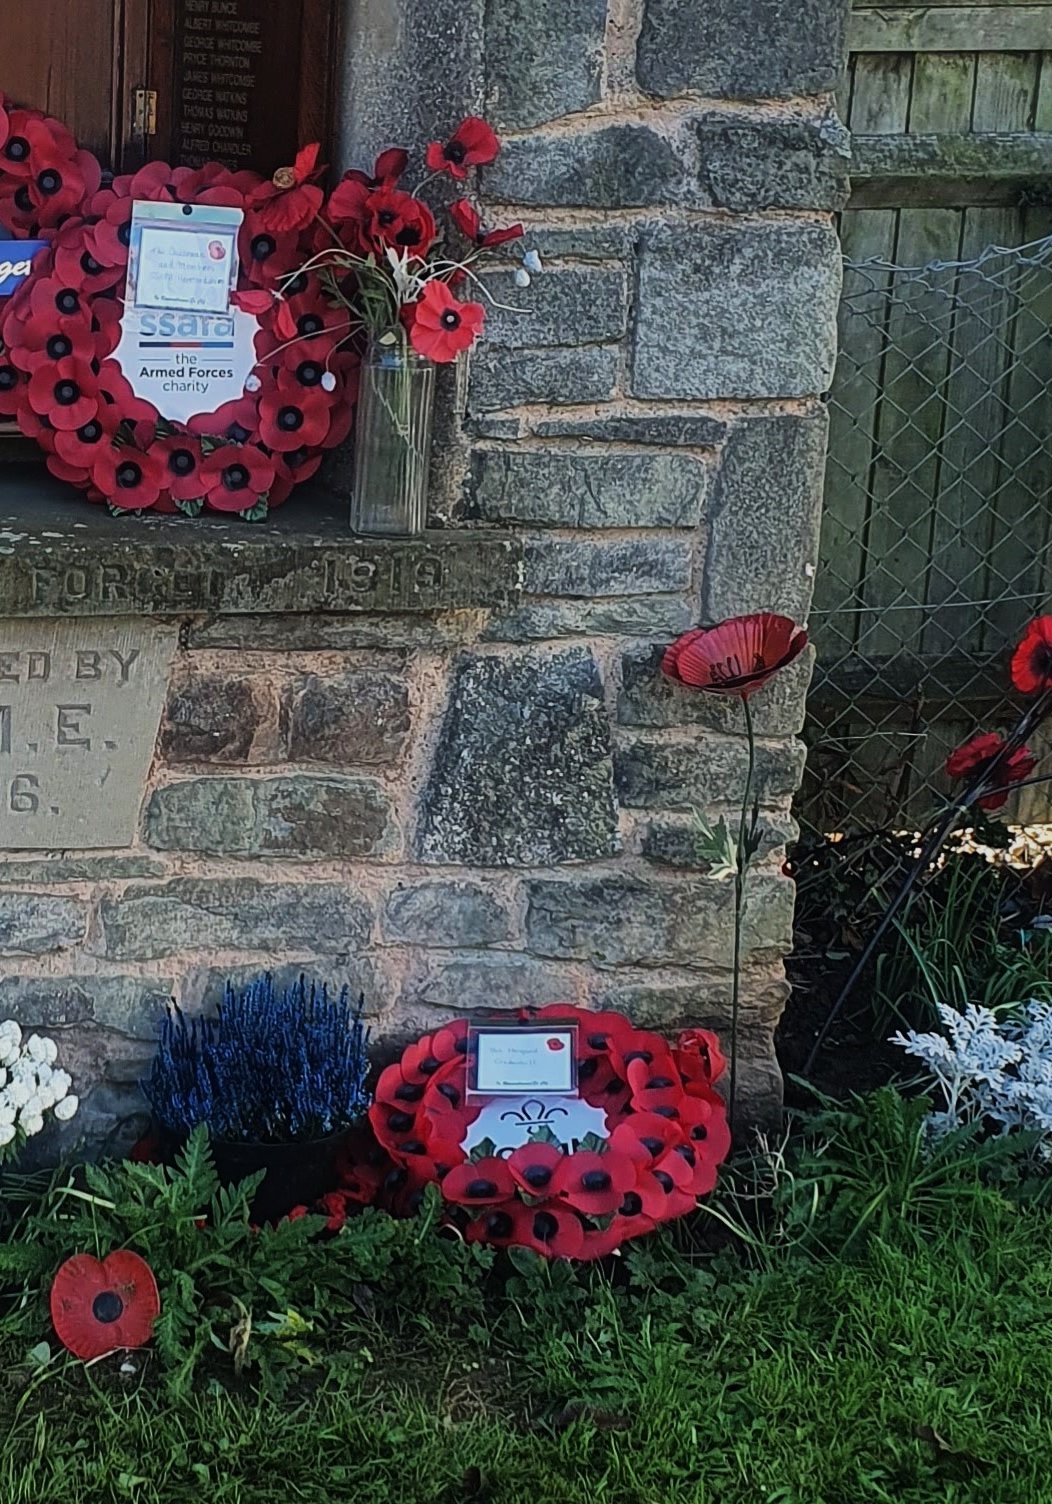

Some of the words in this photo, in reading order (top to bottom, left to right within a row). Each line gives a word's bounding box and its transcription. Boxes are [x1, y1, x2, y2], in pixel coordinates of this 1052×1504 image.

[176, 353, 197, 364] the
[139, 367, 184, 377] Armed
[189, 367, 233, 377] Forces
[163, 380, 208, 393] charity
[75, 648, 140, 686] BY
